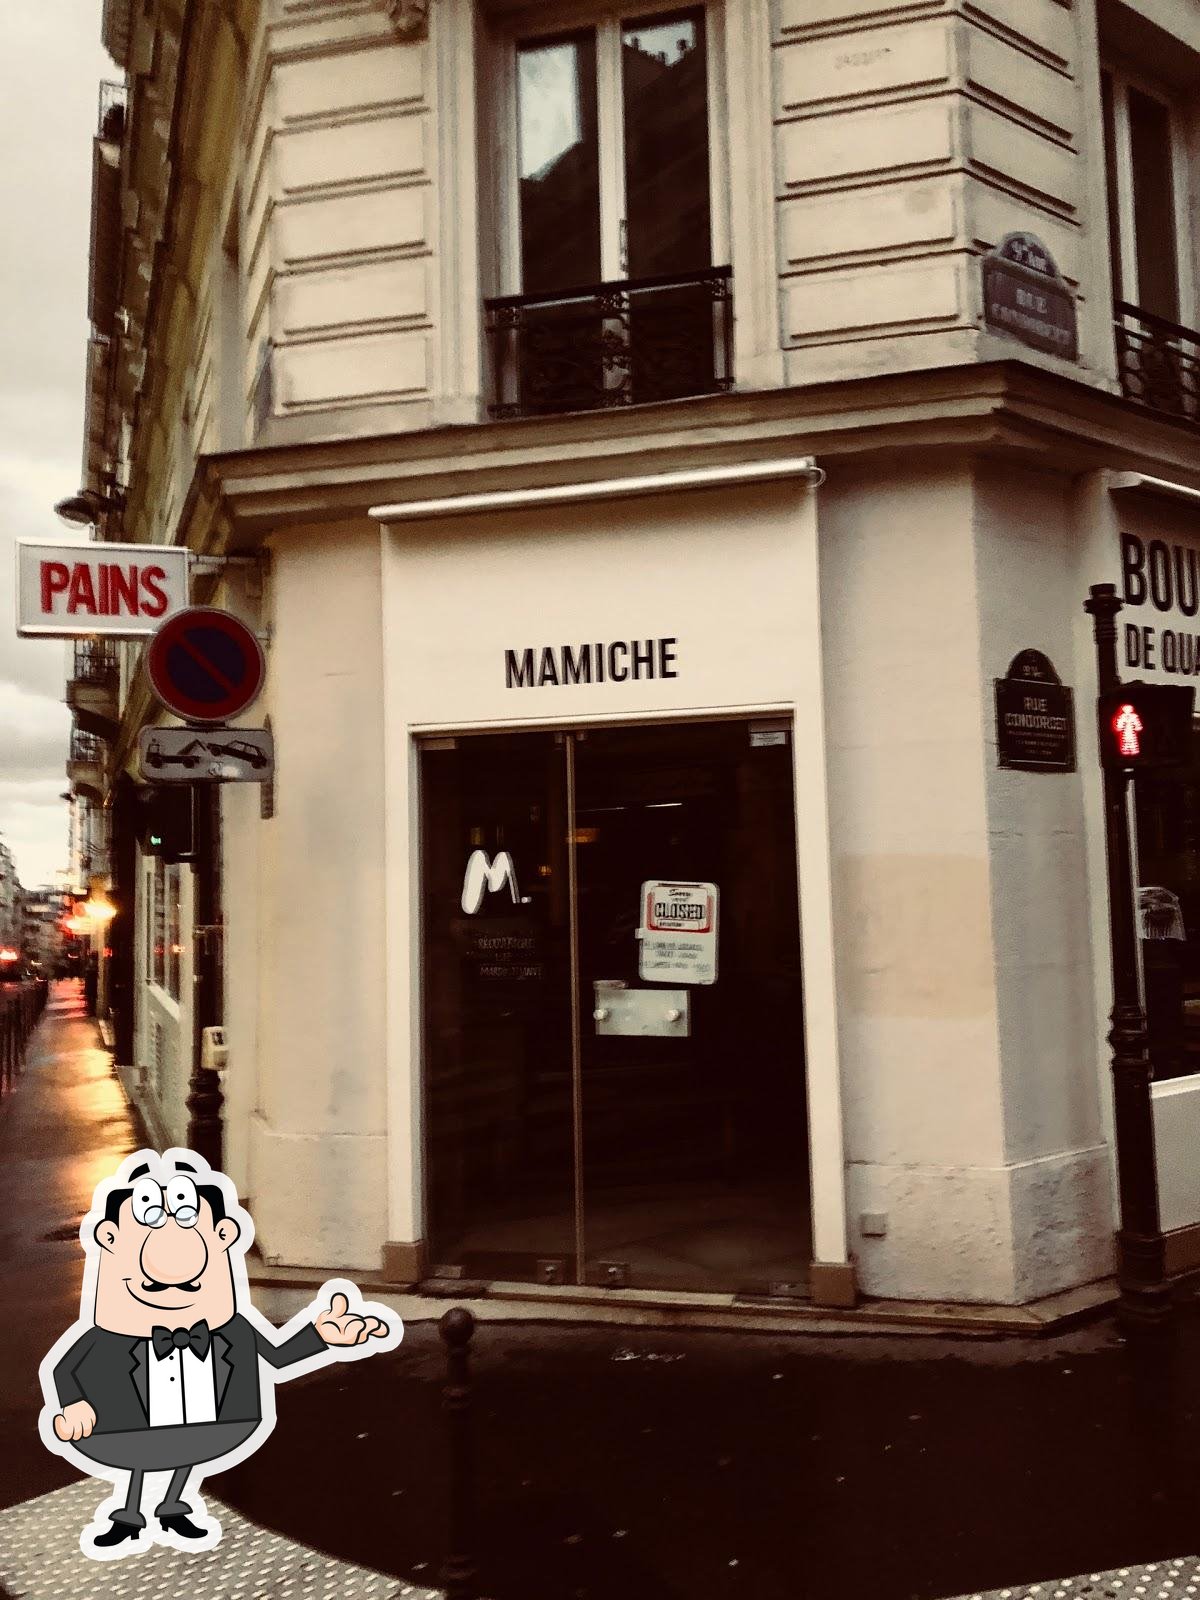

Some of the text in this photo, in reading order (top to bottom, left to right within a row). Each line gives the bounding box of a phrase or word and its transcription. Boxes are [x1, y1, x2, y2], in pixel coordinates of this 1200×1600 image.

[40, 560, 169, 617] PAINS
[504, 637, 680, 688] MAMICHE
[1125, 623, 1156, 670] DE
[1023, 696, 1048, 712] RUE
[654, 902, 705, 920] CLOSED
